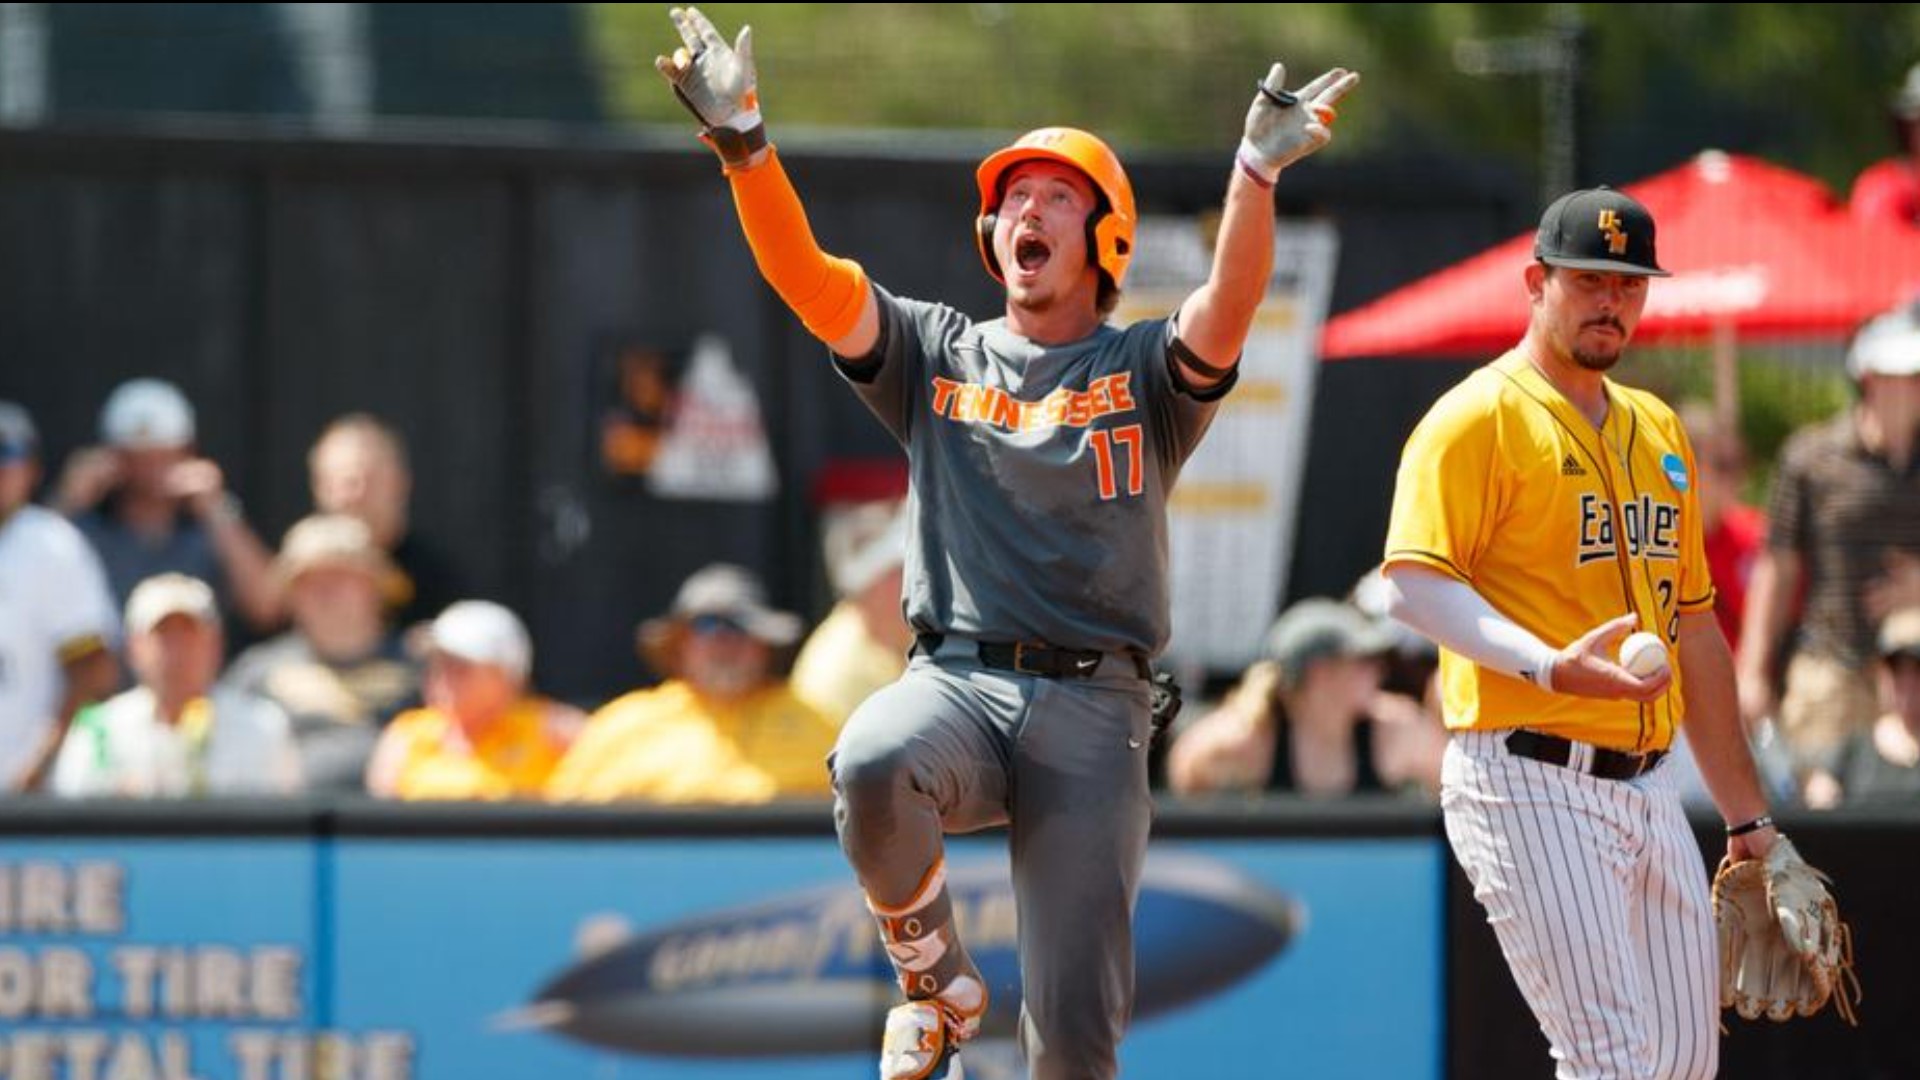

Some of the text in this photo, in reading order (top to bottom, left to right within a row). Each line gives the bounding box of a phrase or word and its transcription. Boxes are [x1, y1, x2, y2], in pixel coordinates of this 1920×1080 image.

[932, 371, 1136, 433] TENNESSEE
[1089, 424, 1143, 500] 17
[112, 944, 299, 1019] TIRE
[0, 1029, 208, 1080] ETAL
